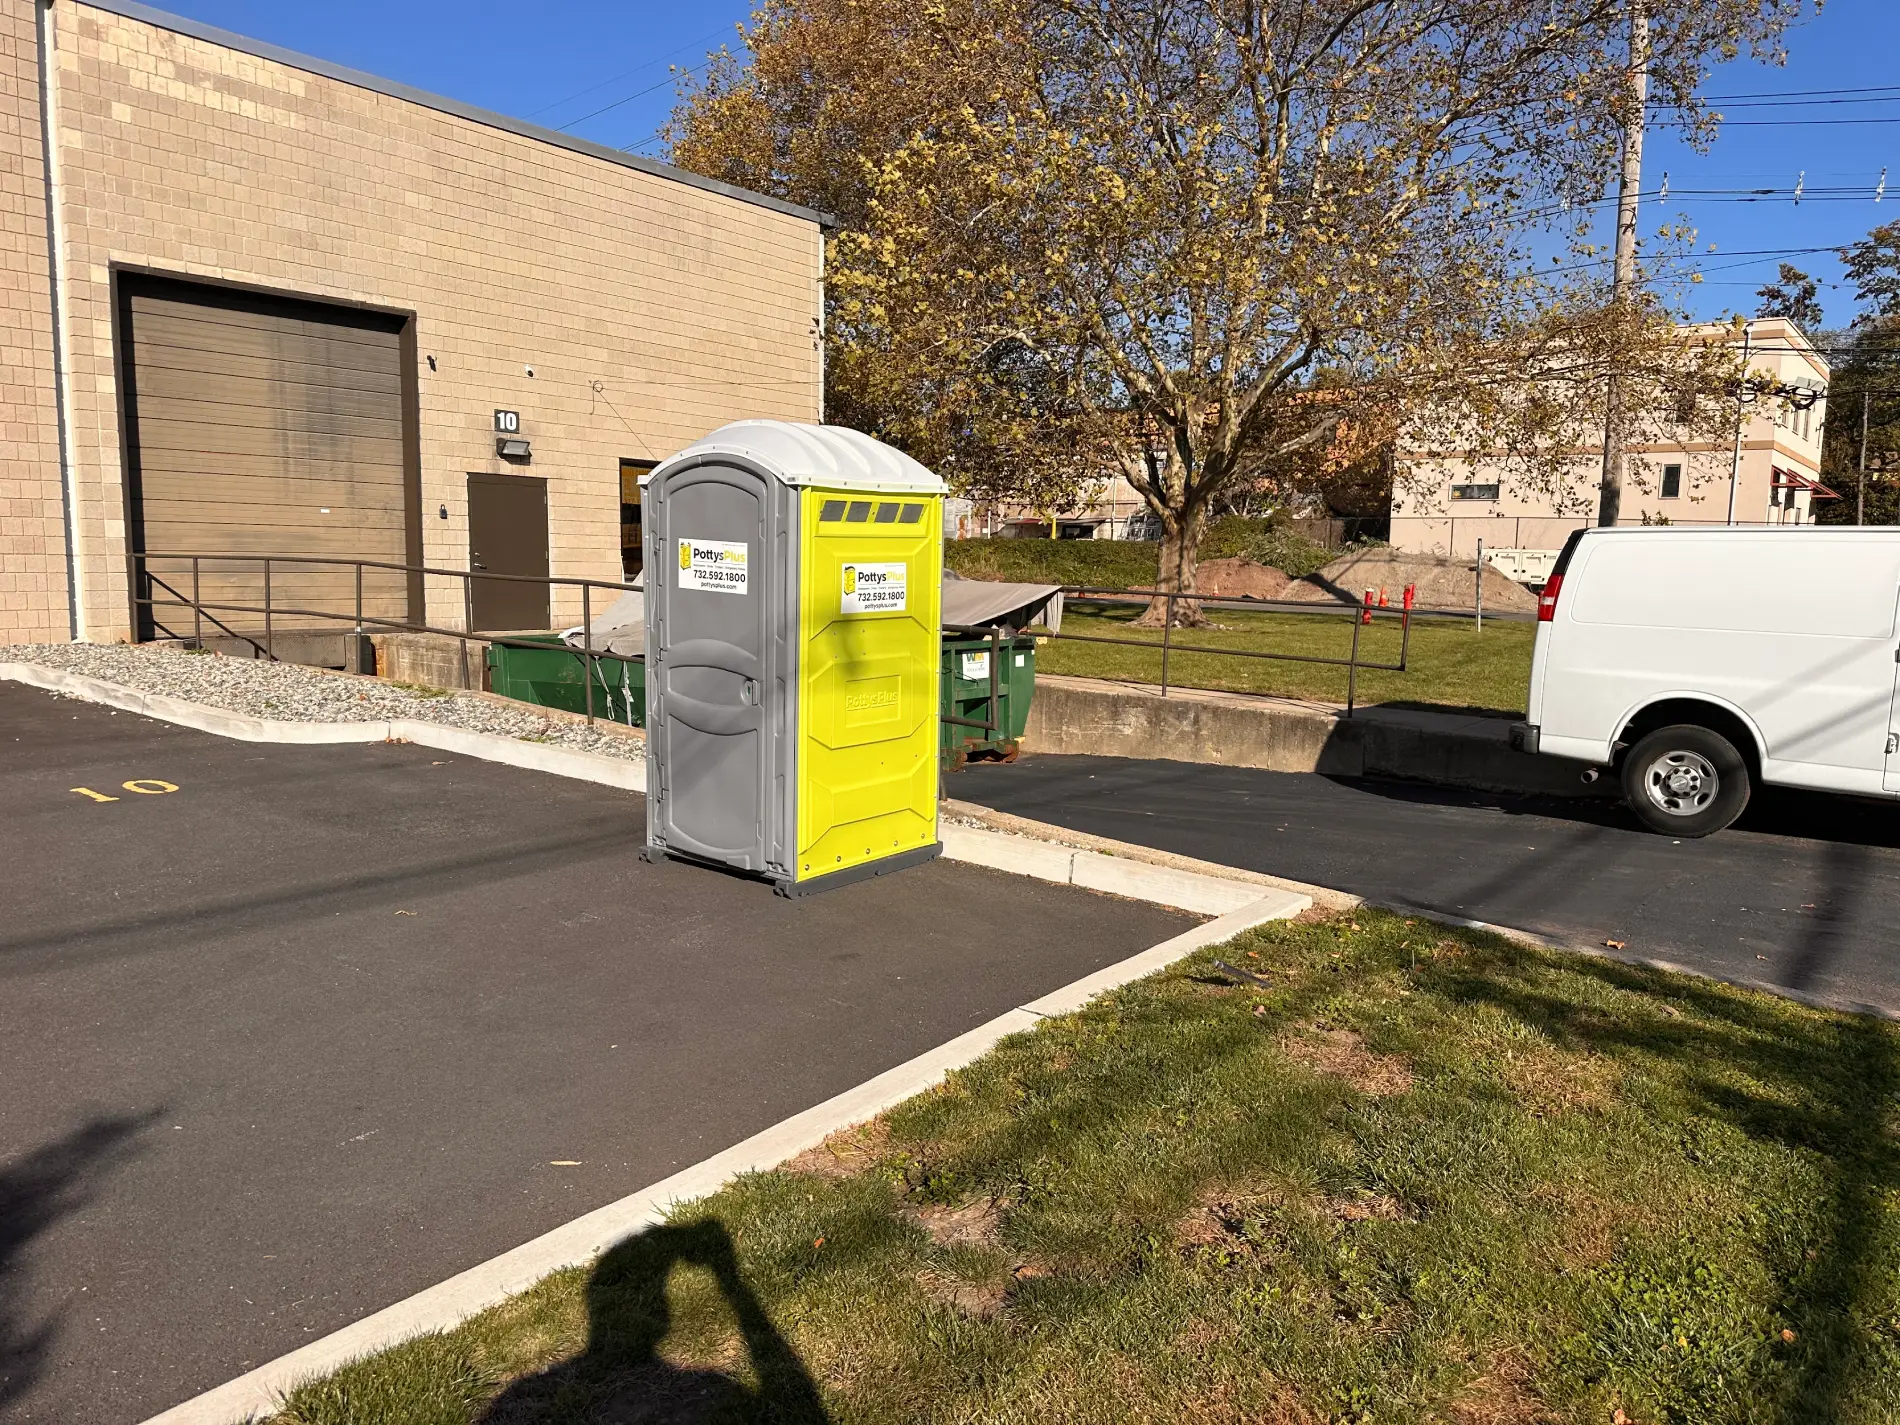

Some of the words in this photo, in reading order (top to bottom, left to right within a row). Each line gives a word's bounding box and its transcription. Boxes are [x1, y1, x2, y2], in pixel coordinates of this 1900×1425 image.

[497, 412, 517, 430] 10
[693, 548, 746, 563] PottysPlus
[693, 570, 746, 582] 732.592.1800
[858, 571, 905, 584] PottysPlus
[701, 582, 737, 590] pottysplus.com
[858, 591, 905, 601] 732.592.1800
[69, 780, 180, 802] 10
